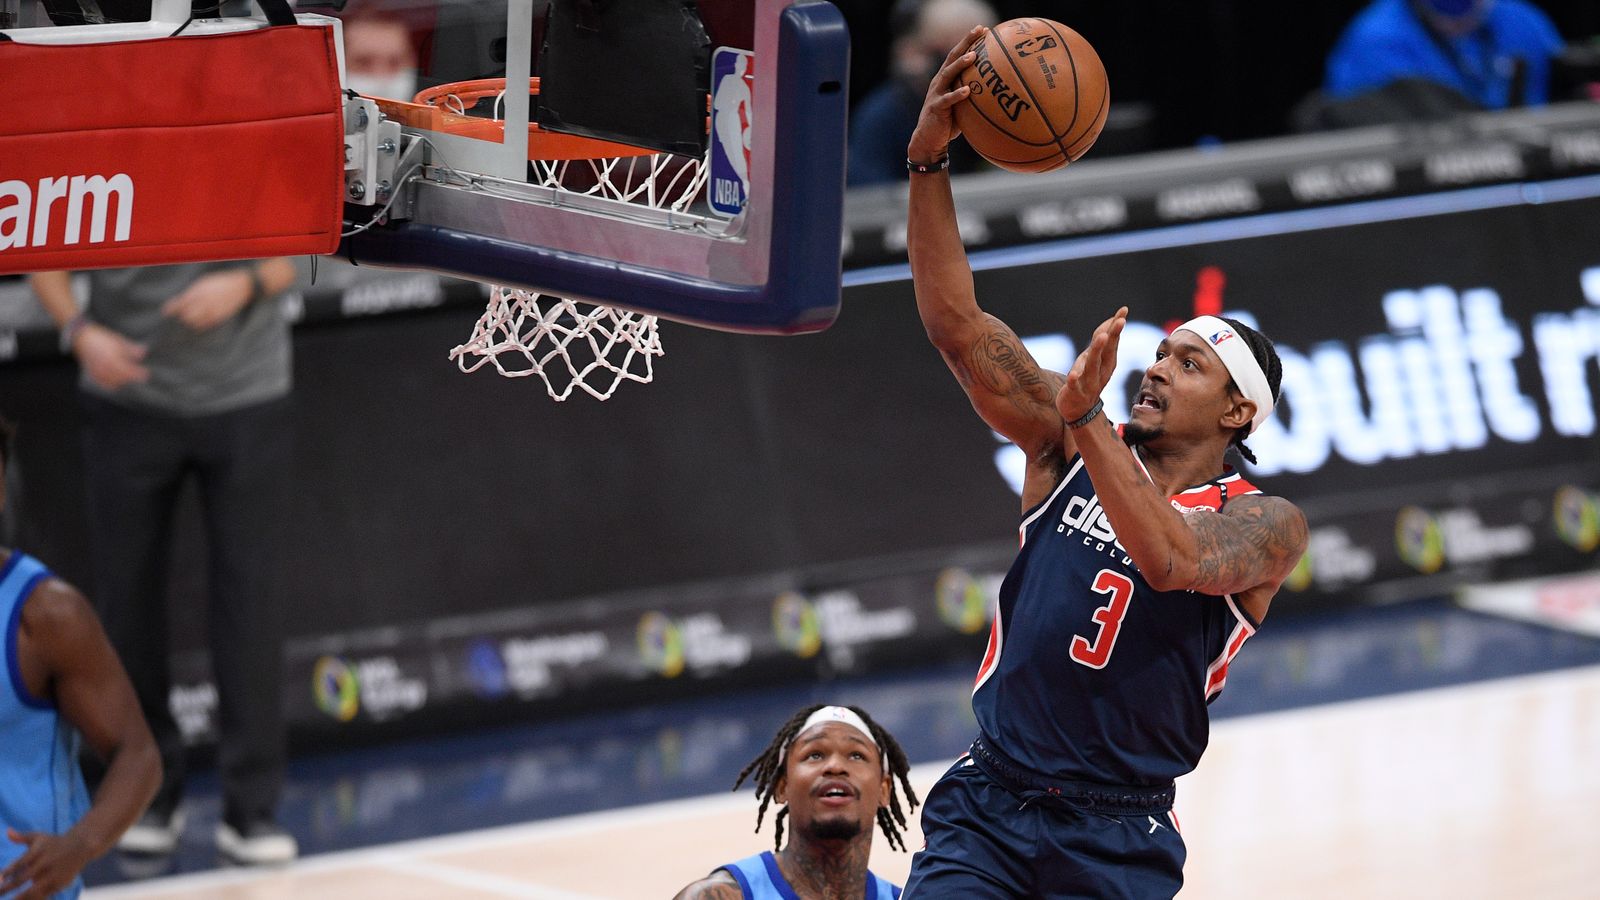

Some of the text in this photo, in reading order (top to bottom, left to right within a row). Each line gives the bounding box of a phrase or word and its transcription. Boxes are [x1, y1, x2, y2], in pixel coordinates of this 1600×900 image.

[715, 177, 740, 207] NBA
[1056, 523, 1140, 572] OF COLU
[1068, 568, 1135, 670] 3
